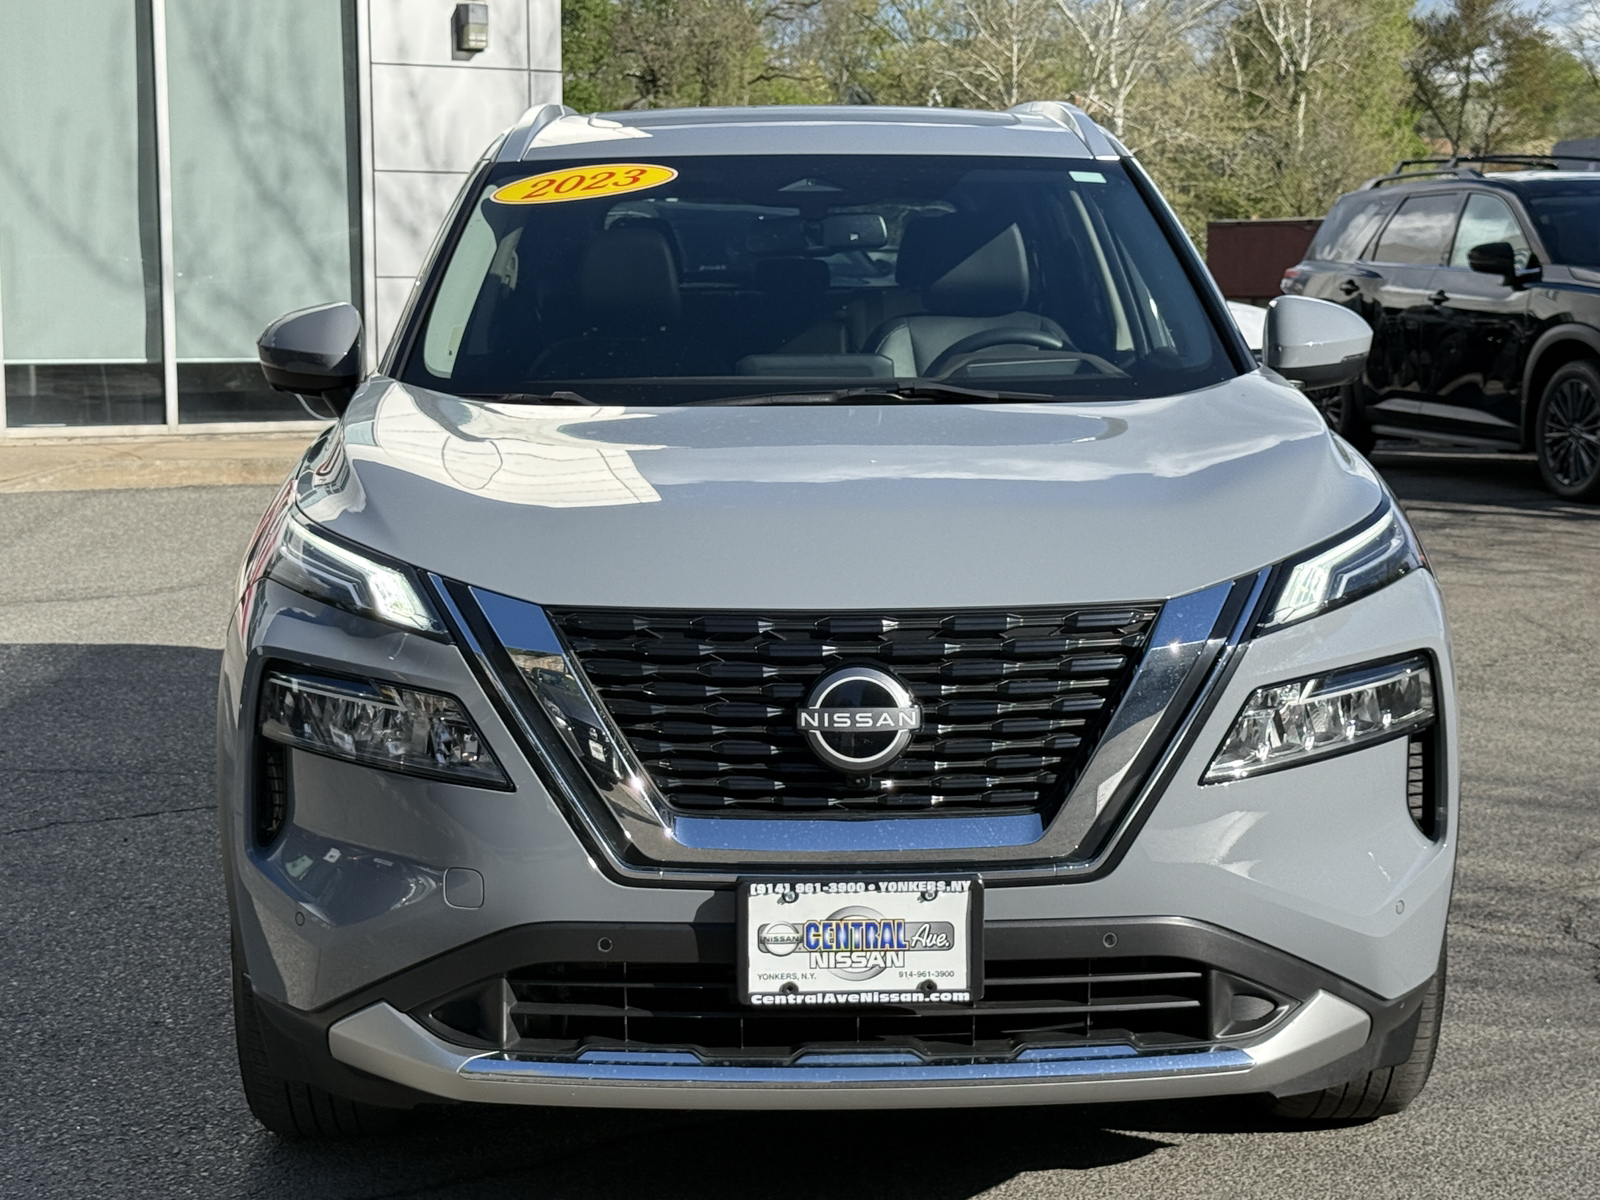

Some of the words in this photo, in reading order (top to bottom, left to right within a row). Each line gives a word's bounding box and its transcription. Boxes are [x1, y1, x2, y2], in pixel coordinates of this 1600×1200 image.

[521, 168, 648, 200] 2023
[800, 711, 917, 728] NISSAN
[795, 882, 866, 894] 961-3900
[763, 935, 800, 943] NISSAN
[803, 919, 910, 952] CENTRAL
[911, 922, 951, 948] Ave.
[809, 951, 905, 969] NISSAN
[757, 972, 800, 981] YONKERS,
[801, 972, 817, 980] N.Y.
[898, 970, 955, 978] 914-961-3900
